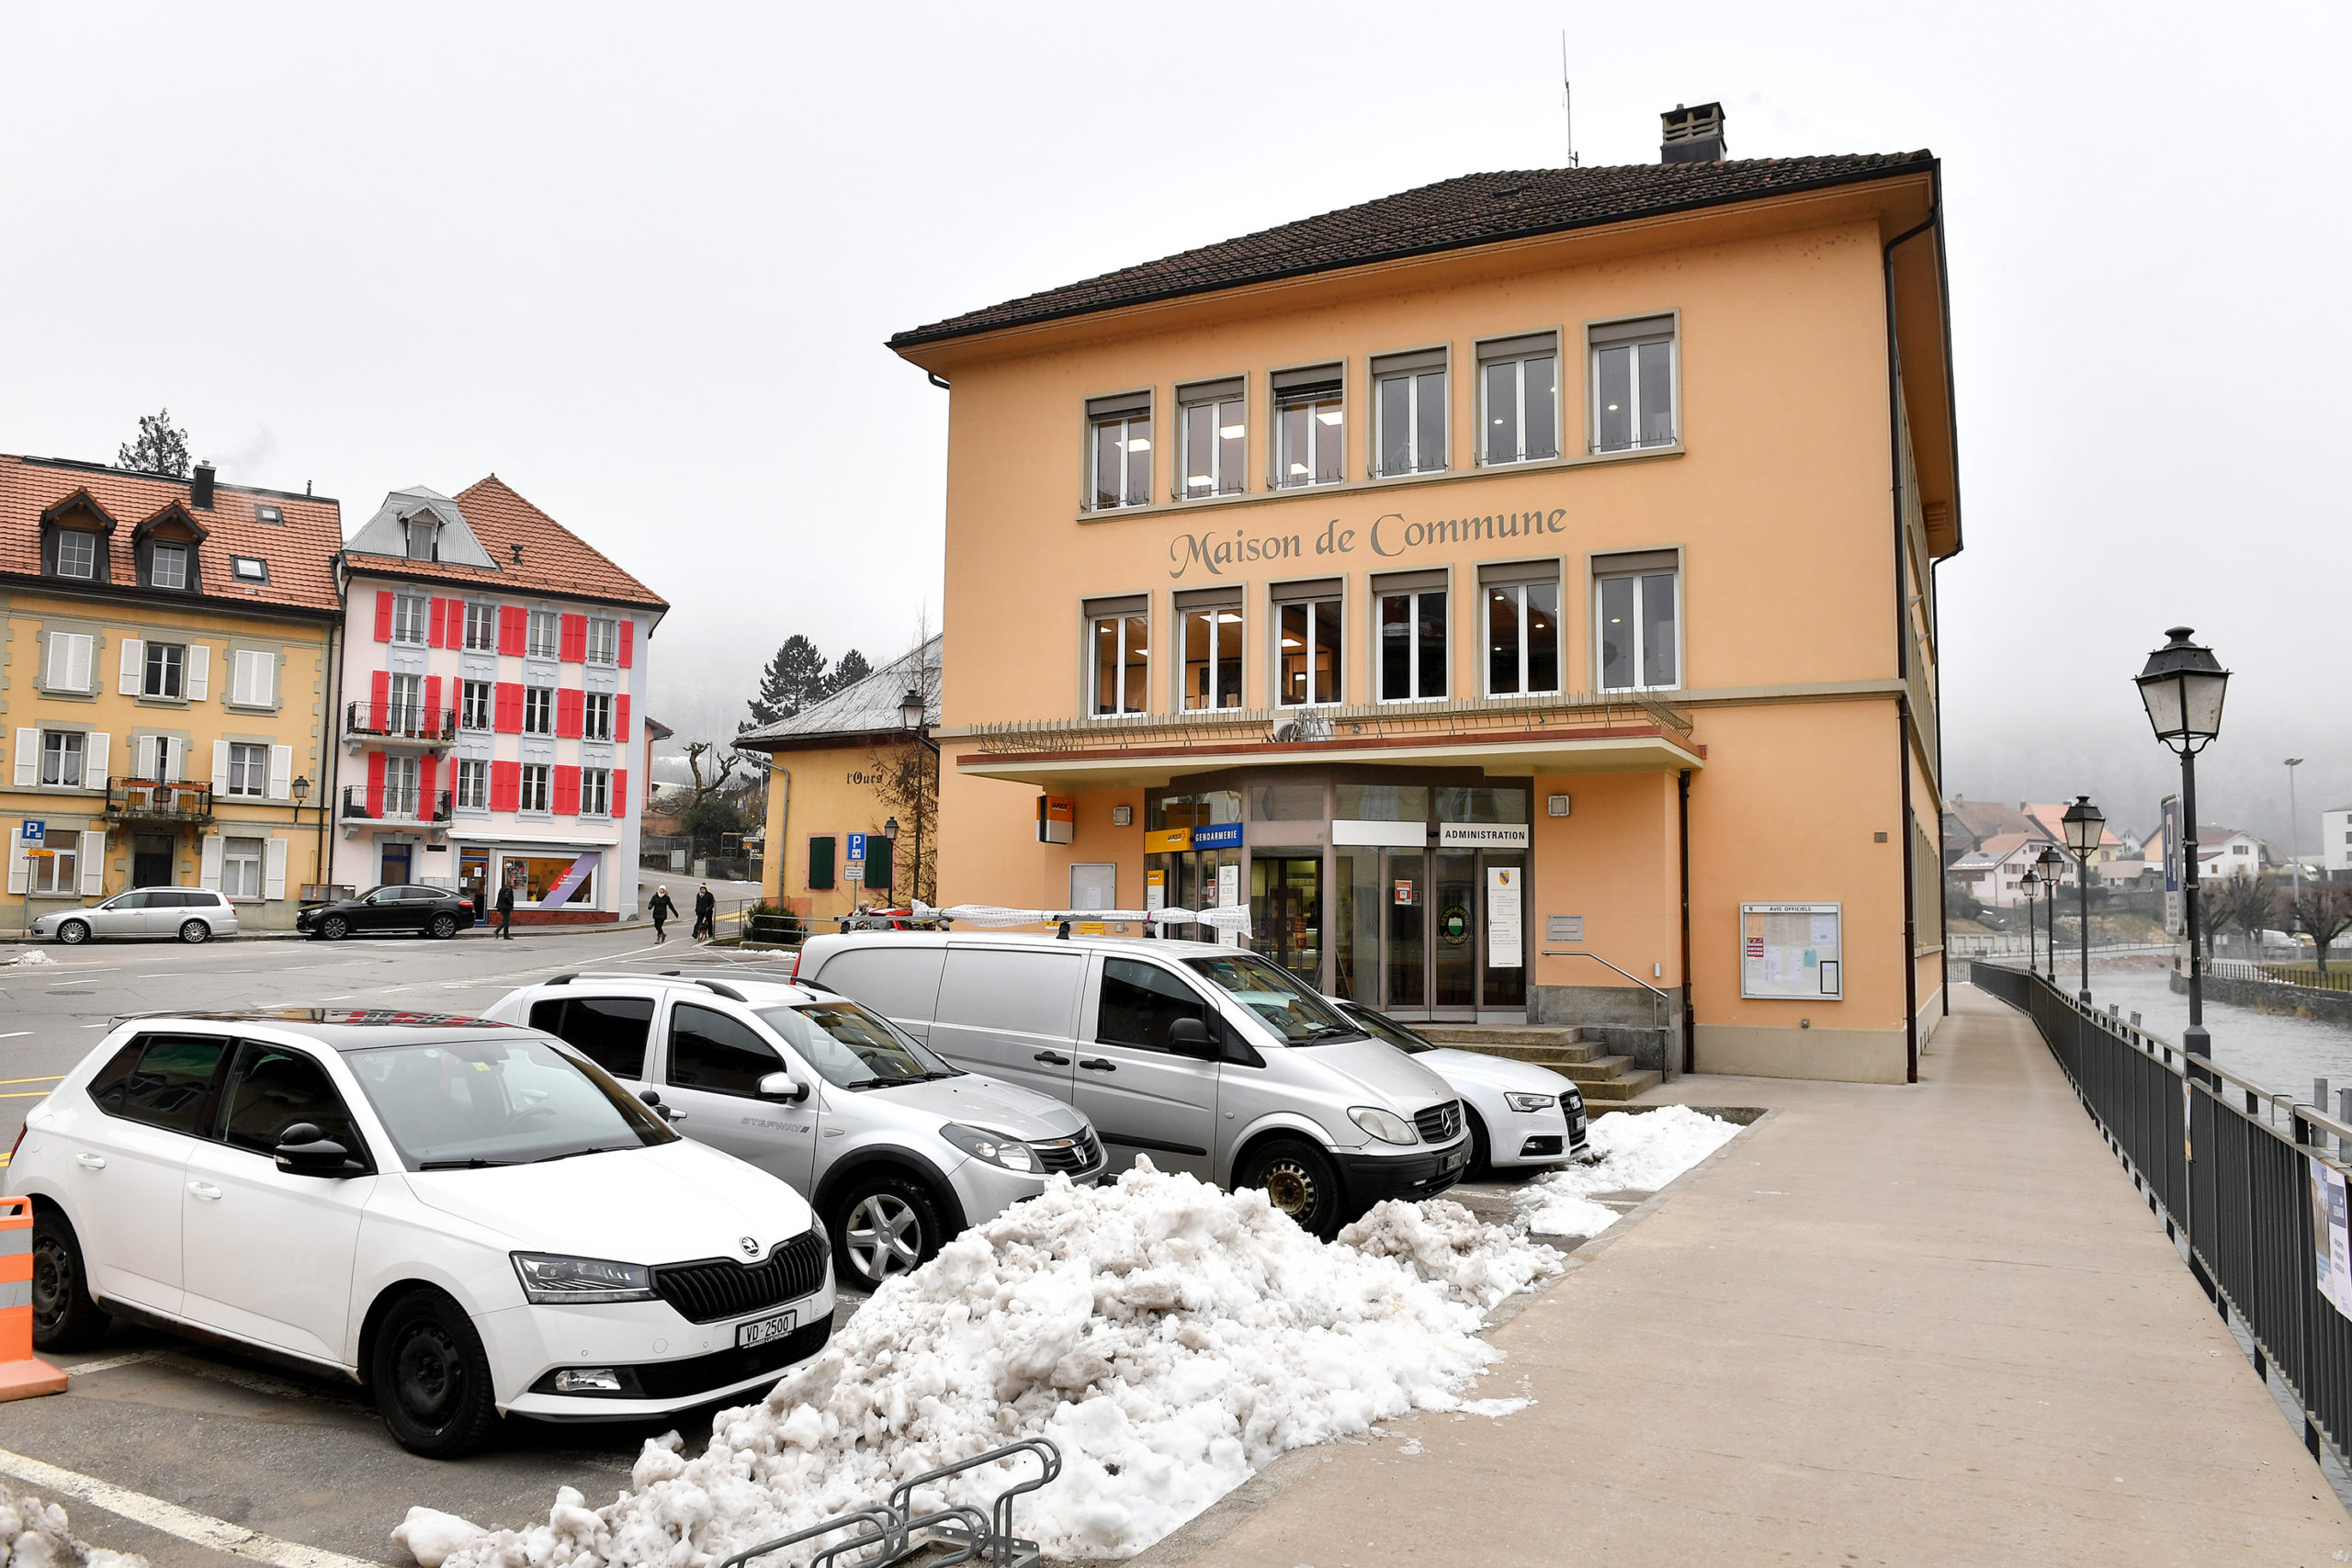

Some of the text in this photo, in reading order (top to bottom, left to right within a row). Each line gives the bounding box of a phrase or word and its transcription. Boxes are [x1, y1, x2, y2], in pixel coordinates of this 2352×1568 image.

[1169, 508, 1566, 579] Maison de Commune
[26, 822, 38, 837] P
[1195, 829, 1238, 842] GENDARMERIE
[1445, 829, 1525, 840] ADMINISTRATION
[853, 835, 861, 849] P
[741, 1117, 801, 1132] STEPWAY
[747, 1316, 788, 1342] VD 2500
